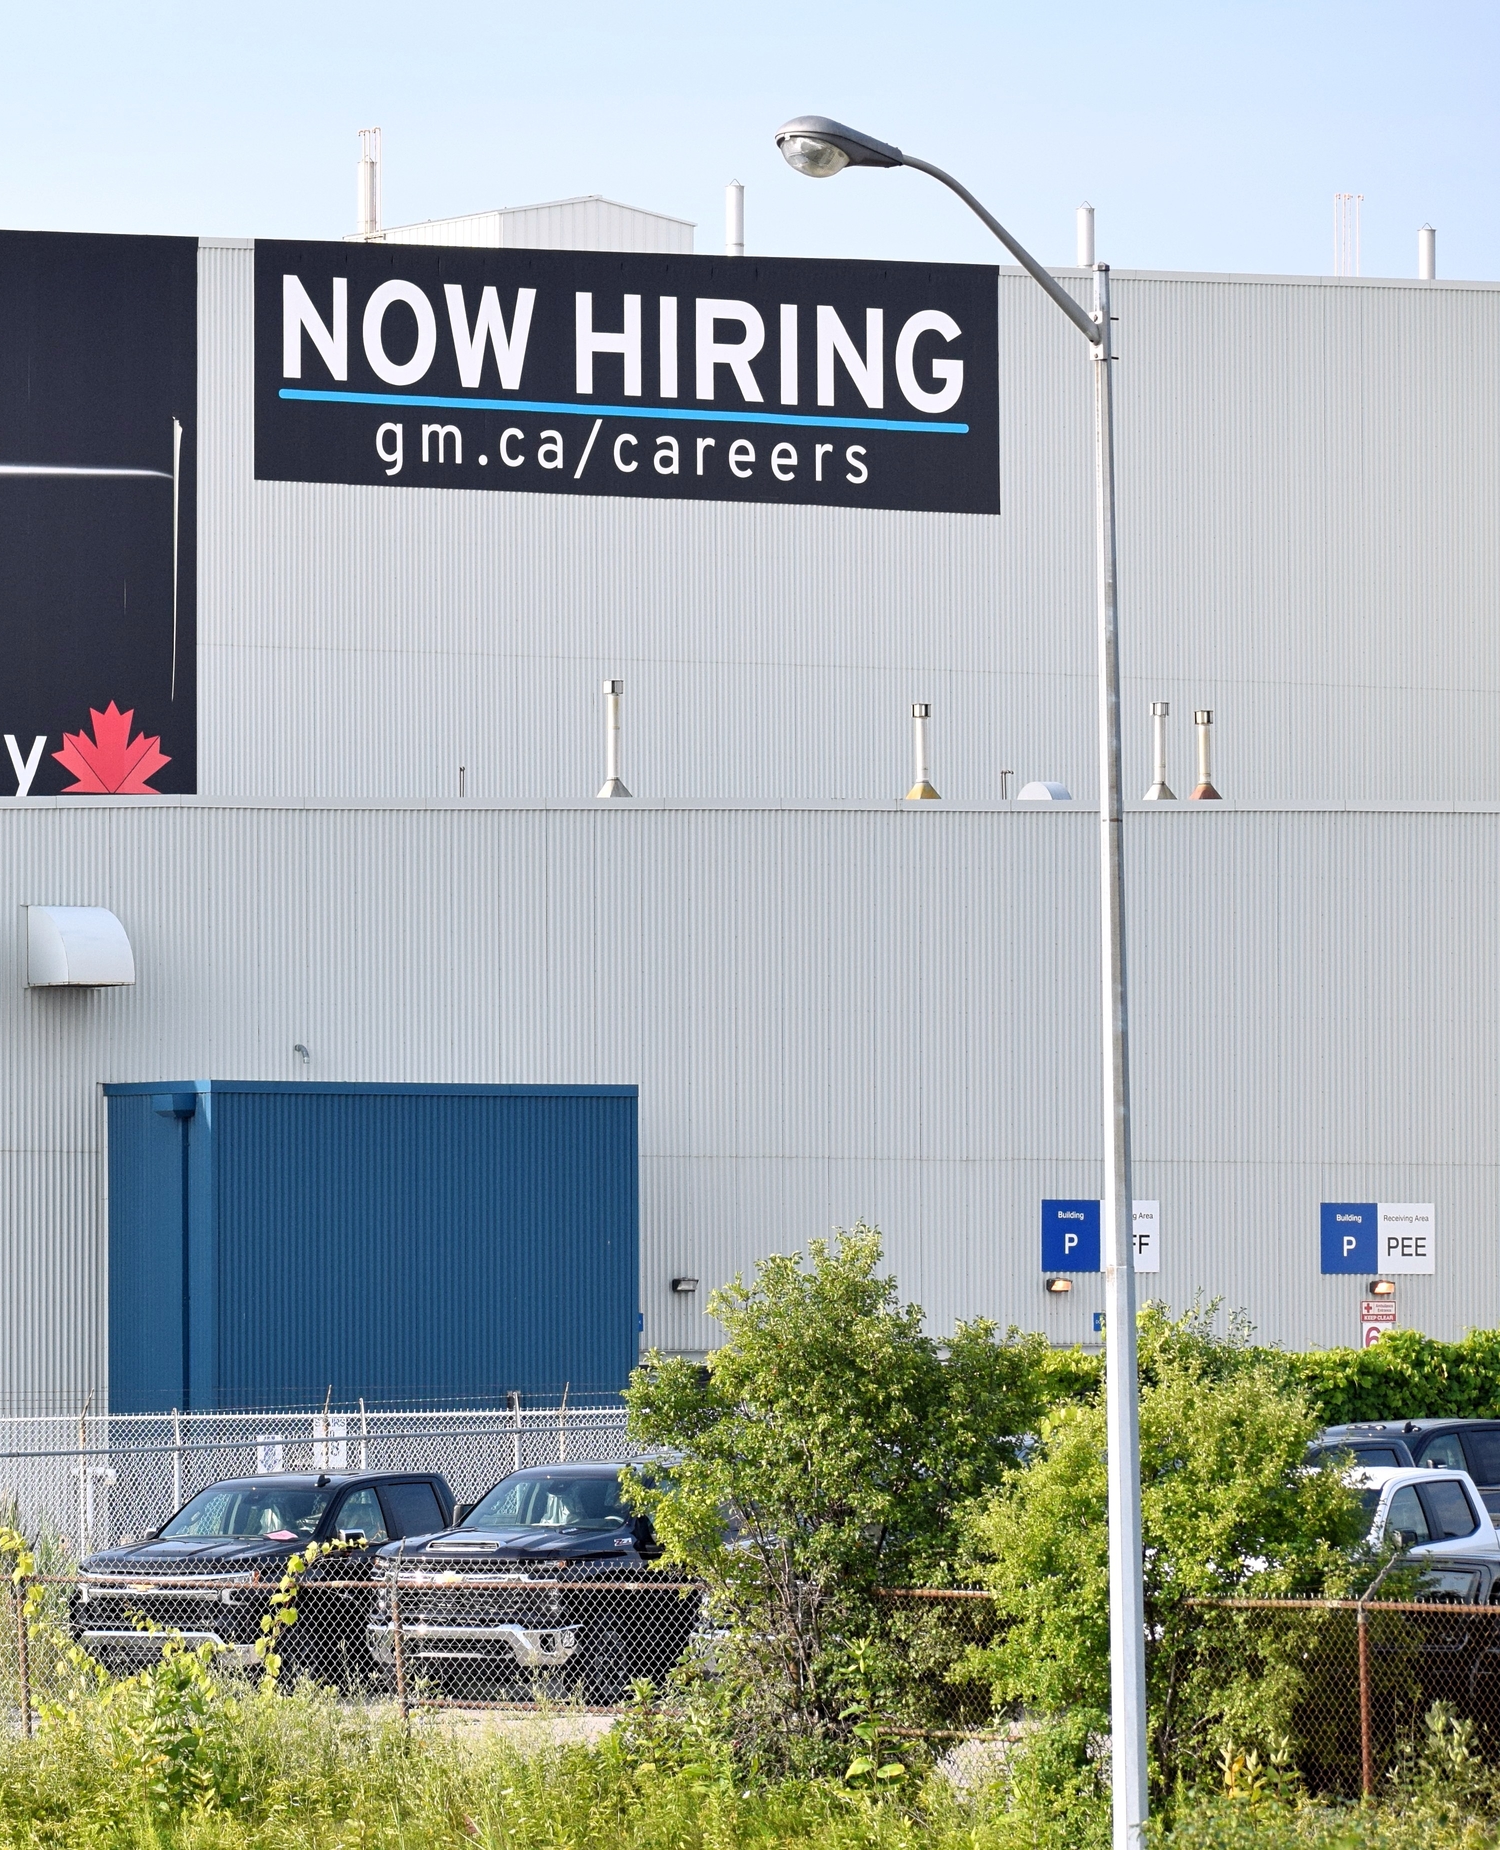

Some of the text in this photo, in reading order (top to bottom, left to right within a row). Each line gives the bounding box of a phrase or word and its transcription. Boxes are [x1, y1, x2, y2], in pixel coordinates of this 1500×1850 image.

[282, 274, 964, 414] NOW HIRING
[375, 418, 869, 484] gm.ca/careers
[1057, 1211, 1085, 1220] Building
[1138, 1212, 1154, 1220] Area
[1336, 1214, 1362, 1223] Building
[1383, 1215, 1413, 1223] Receiving
[1064, 1233, 1078, 1254] P
[1343, 1236, 1357, 1257] P
[1387, 1237, 1427, 1257] PEE
